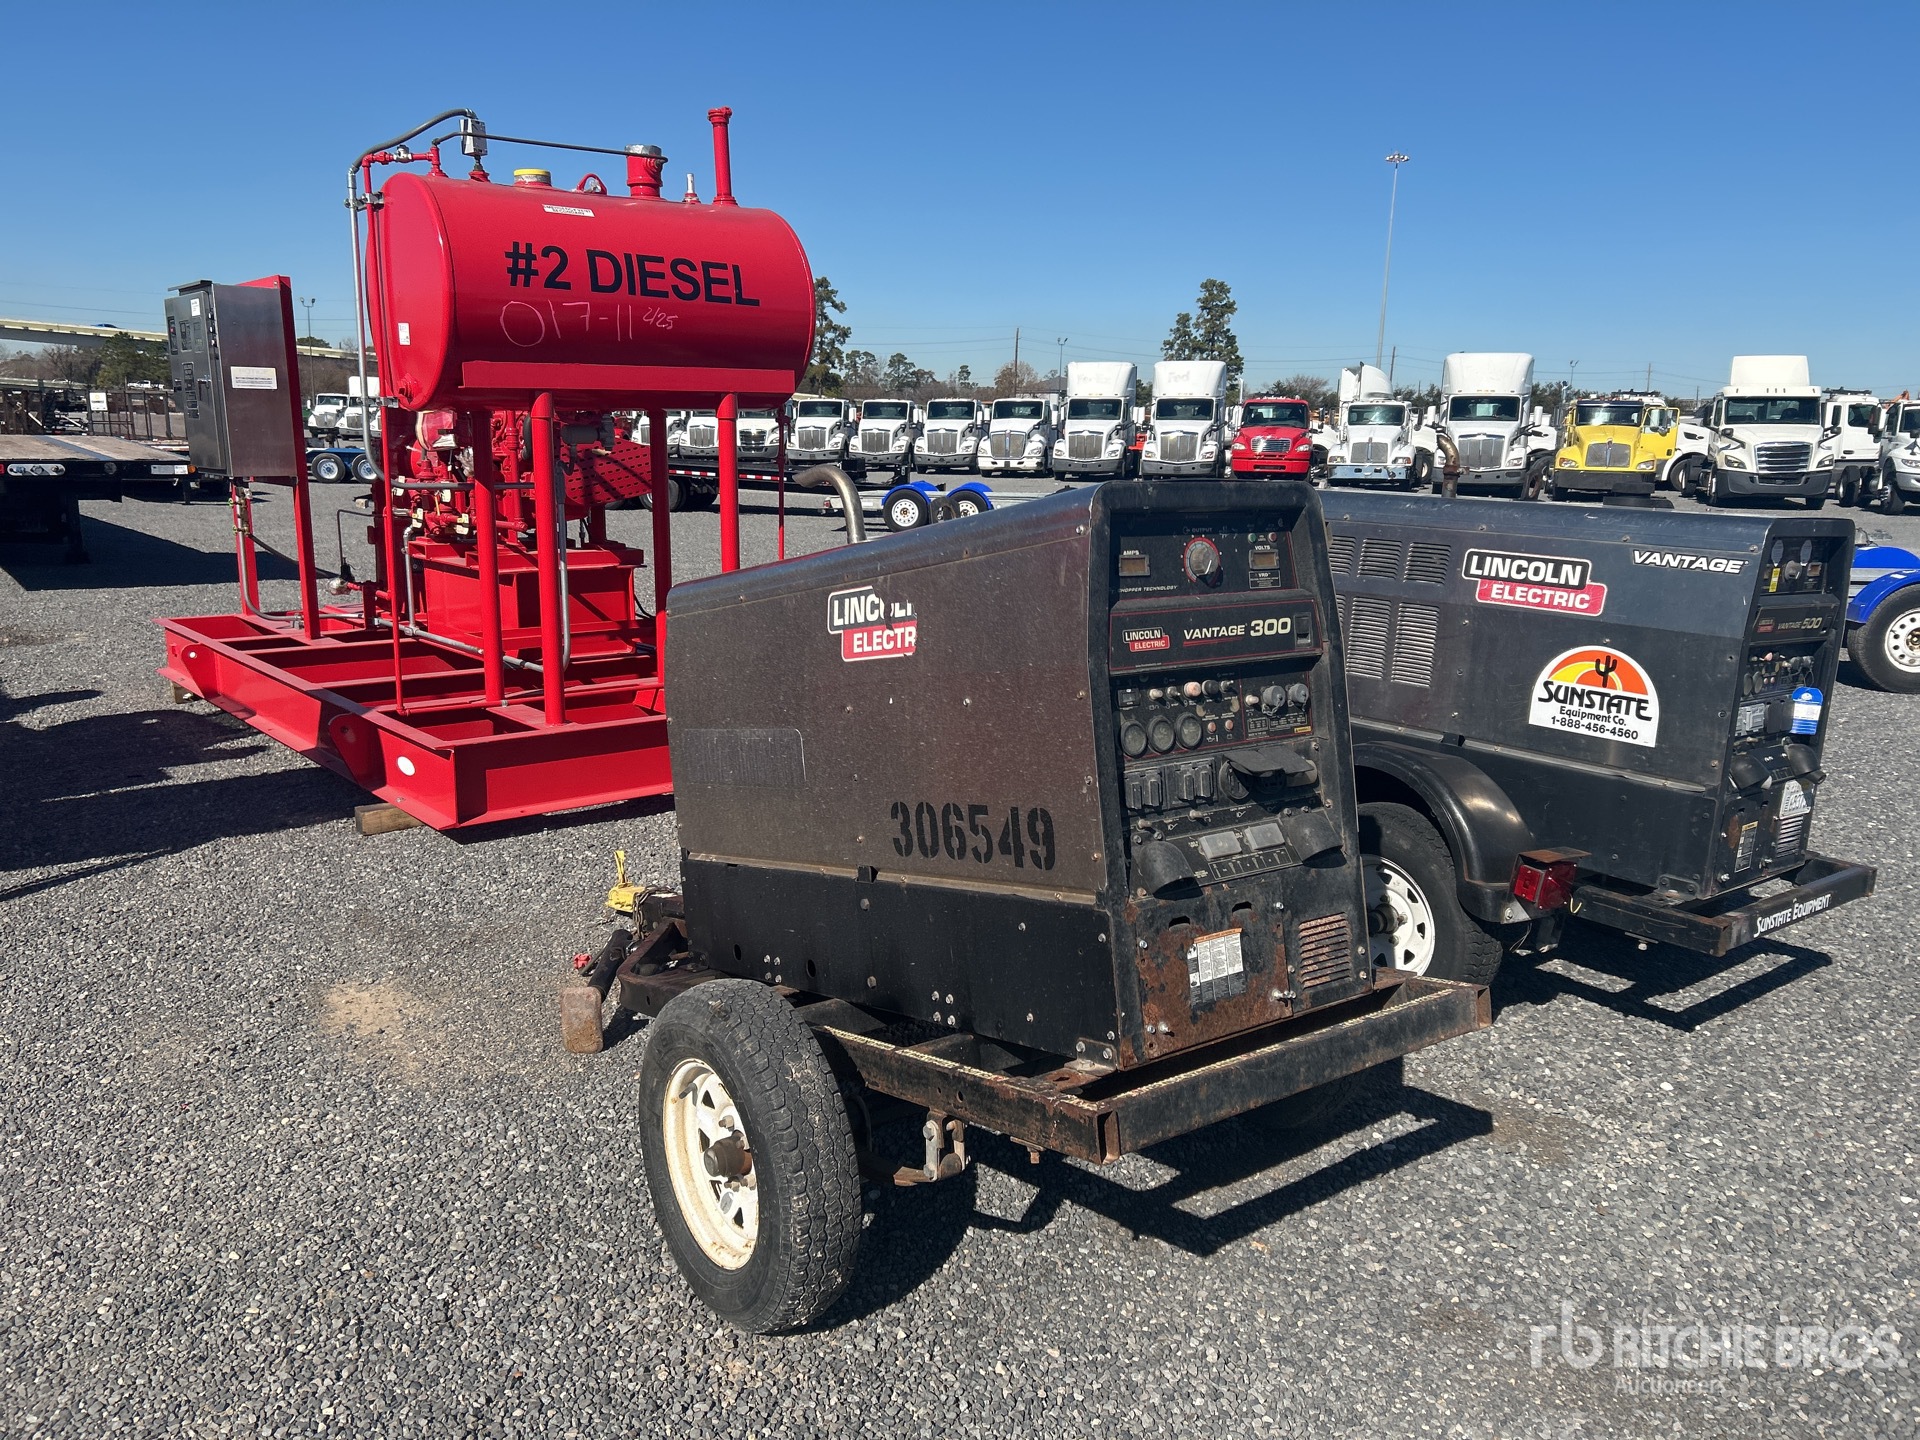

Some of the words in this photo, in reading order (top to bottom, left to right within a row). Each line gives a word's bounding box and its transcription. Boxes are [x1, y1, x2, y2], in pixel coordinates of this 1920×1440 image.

[504, 241, 571, 290] #2
[586, 249, 760, 306] DIESEL
[1469, 555, 1583, 586] LINCOLN
[1633, 550, 1741, 574] VANTAGE
[1491, 583, 1591, 610] ELECTRIC
[1125, 628, 1162, 641] LINCOLN
[1183, 625, 1246, 640] VANTAGE
[1250, 617, 1292, 637] 300
[1801, 617, 1823, 630] 500
[1134, 640, 1166, 650] ELECTRIC
[1538, 680, 1653, 722] SUNSTATE
[1551, 716, 1639, 741] 1-888-456-4560
[1559, 706, 1612, 724] Equipment
[1613, 714, 1627, 727] Co.
[890, 801, 1056, 871] 306549
[1754, 904, 1792, 938] SUNSTATE
[1792, 893, 1832, 921] EQUIPMENT
